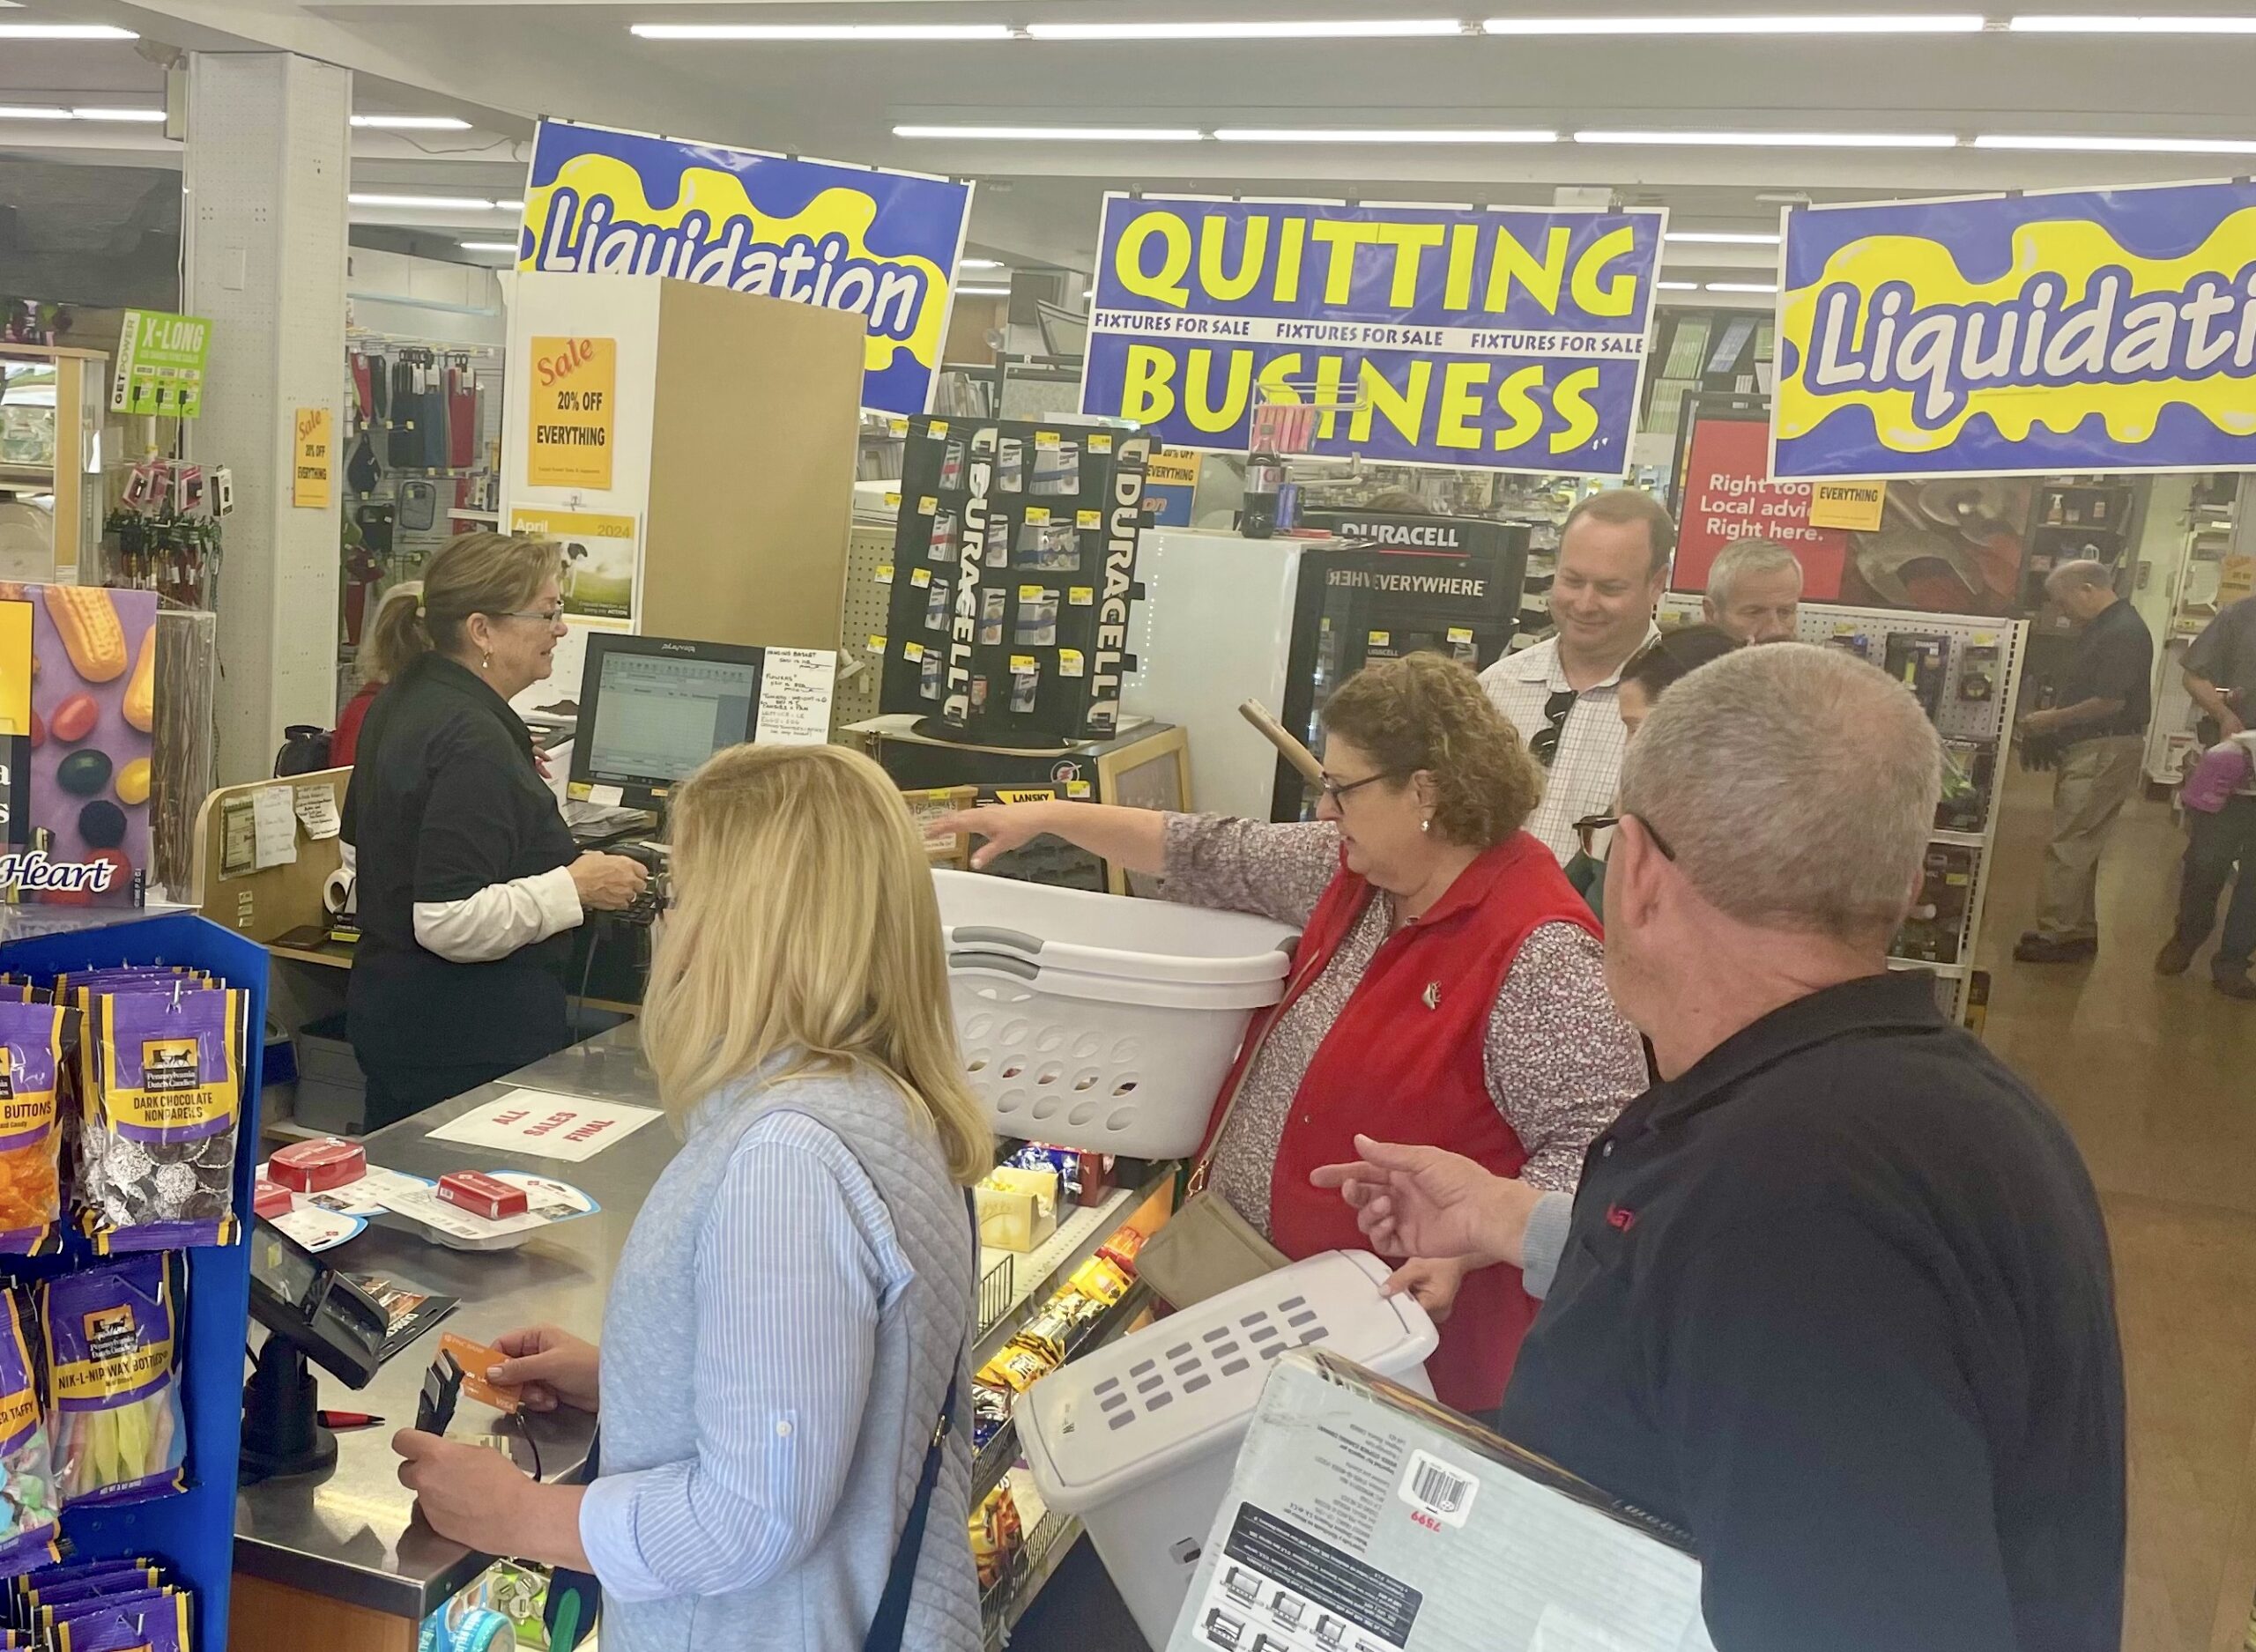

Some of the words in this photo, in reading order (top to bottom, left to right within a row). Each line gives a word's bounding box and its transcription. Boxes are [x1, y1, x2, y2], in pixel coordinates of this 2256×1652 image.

[1114, 211, 1638, 318] QUITTING
[142, 317, 205, 352] X-LONG
[1095, 312, 1170, 332] FIXTURES
[1174, 319, 1208, 335] FOR
[1212, 320, 1250, 337] SALE
[1276, 322, 1362, 344] FIXTURES
[1363, 325, 1399, 345] FOR
[1402, 328, 1443, 347] SALE
[1471, 331, 1553, 353] FIXTURES
[1555, 335, 1588, 353] FOR
[1591, 336, 1644, 354] SALE
[1817, 272, 2256, 420] Liquidati
[536, 337, 594, 388] Sale
[557, 390, 580, 411] 20%
[582, 391, 604, 411] OFF
[1120, 344, 1599, 455] BUSINESS
[298, 410, 323, 441] Sale
[537, 425, 605, 446] EVERYTHING
[315, 445, 326, 458] OFF
[297, 466, 327, 480] EVERYTHING
[1146, 465, 1195, 482] EVERYTHING
[1709, 473, 1767, 497] Right
[1819, 486, 1879, 503] EVERYTHING
[1699, 495, 1755, 515] Local
[514, 518, 548, 534] April
[597, 525, 631, 539] 2024
[1341, 522, 1459, 548] DURACELL
[1706, 517, 1763, 540] Right
[1769, 519, 1824, 542] here.
[946, 463, 992, 691] DURACELL
[1091, 471, 1144, 698] DURACELL
[1374, 574, 1485, 597] VERYWHERE
[1012, 792, 1050, 803] LANSKY
[4, 851, 116, 891] Heart
[4, 1100, 52, 1119] BUTTONS
[133, 1096, 159, 1109] DARK
[160, 1092, 213, 1107] CHOCOLATE
[491, 1110, 531, 1125] ALL
[523, 1111, 578, 1137] SALES
[563, 1120, 616, 1142] FINAL
[58, 1369, 105, 1390] NIK-L-NIP
[107, 1361, 130, 1378] WAX
[11, 1402, 33, 1419] TAFFY
[495, 1396, 515, 1411] VISA
[1410, 1510, 1443, 1533] 7599
